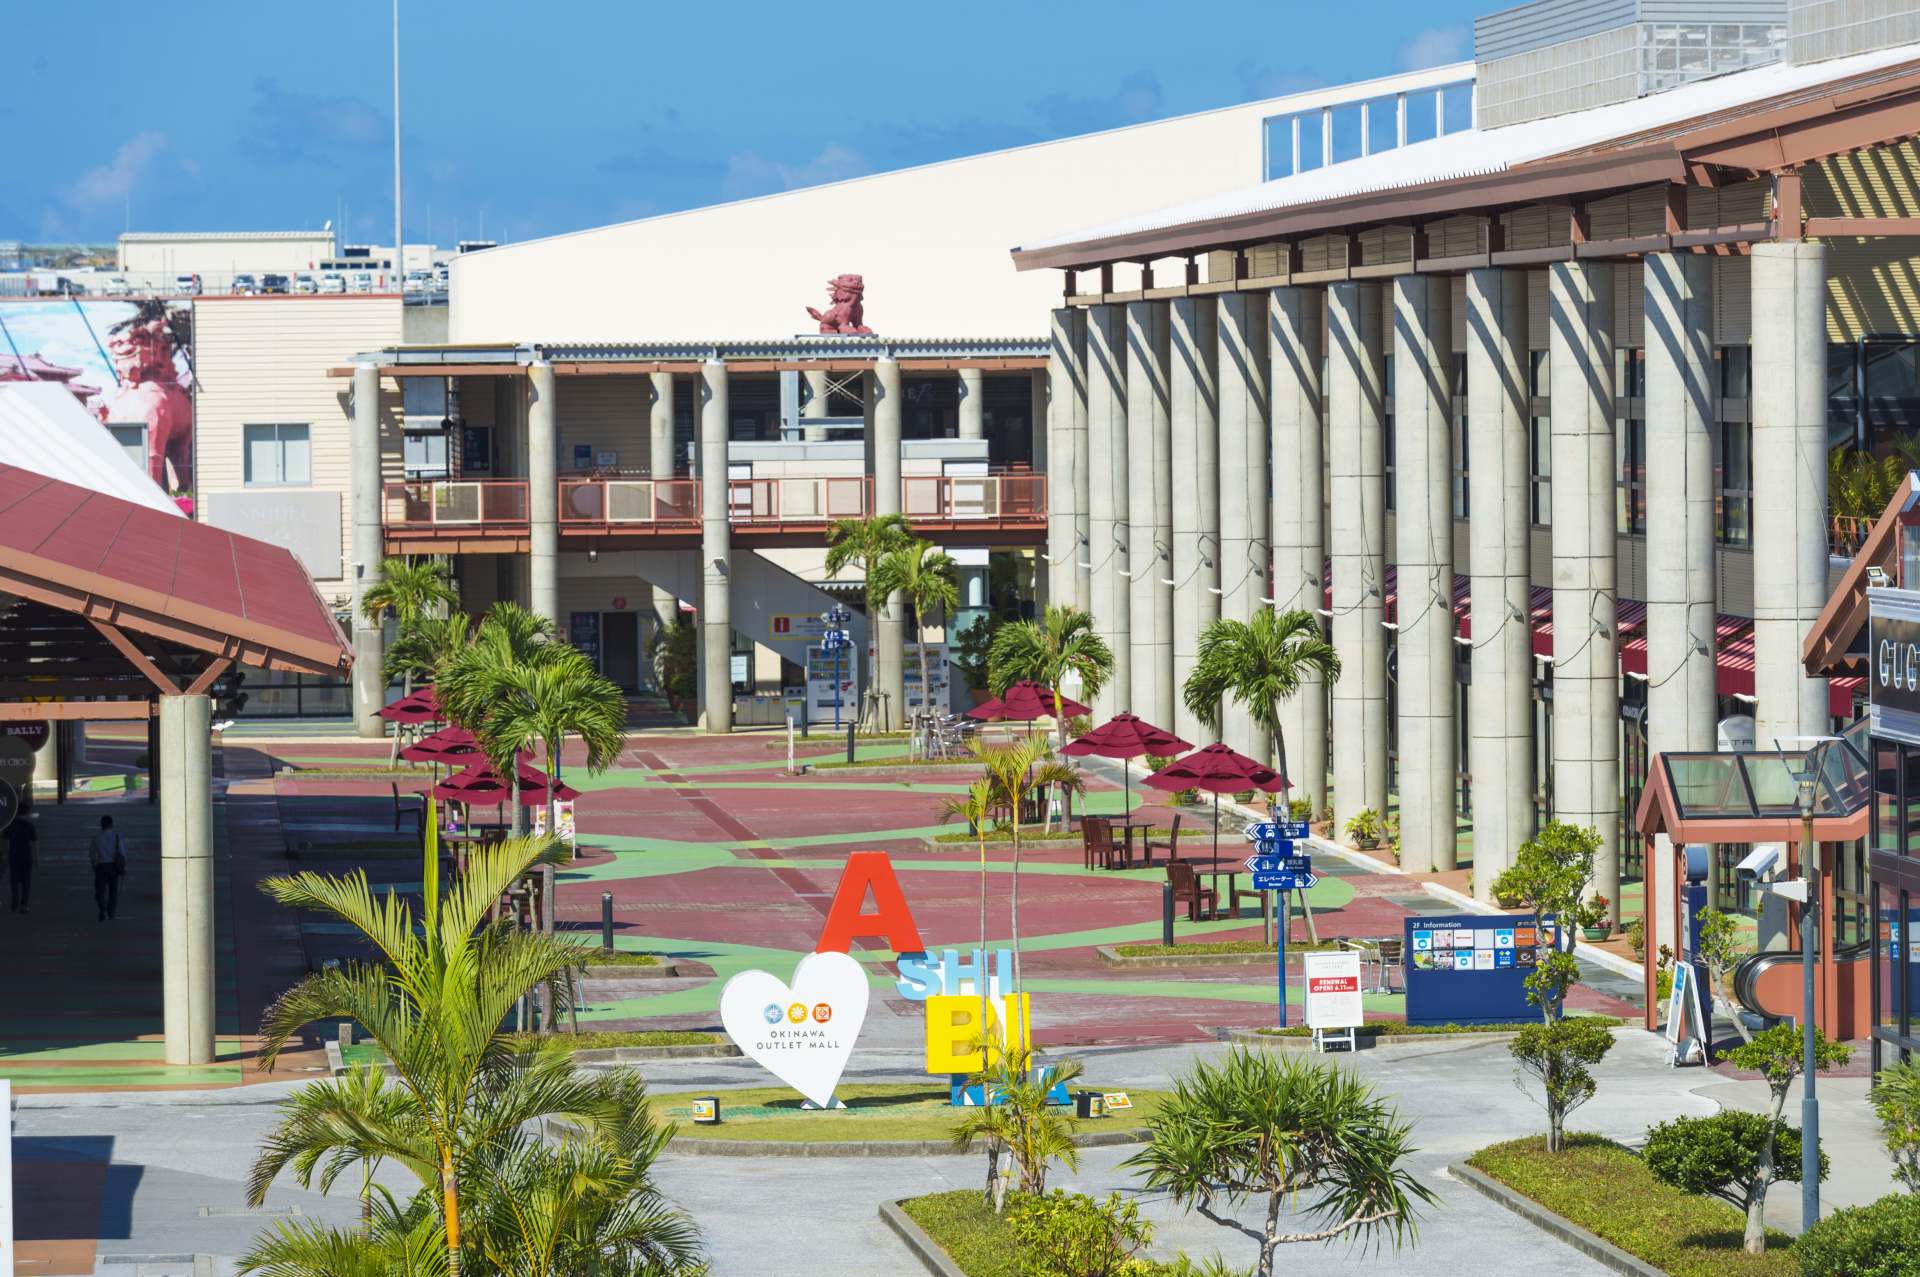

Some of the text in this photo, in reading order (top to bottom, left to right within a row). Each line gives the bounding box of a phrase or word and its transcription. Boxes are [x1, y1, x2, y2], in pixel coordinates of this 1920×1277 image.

[7, 727, 42, 735] BALLY
[1423, 921, 1462, 929] Information
[770, 1029, 825, 1039] OKINAWA
[756, 1040, 840, 1050] OUTLET MALL
